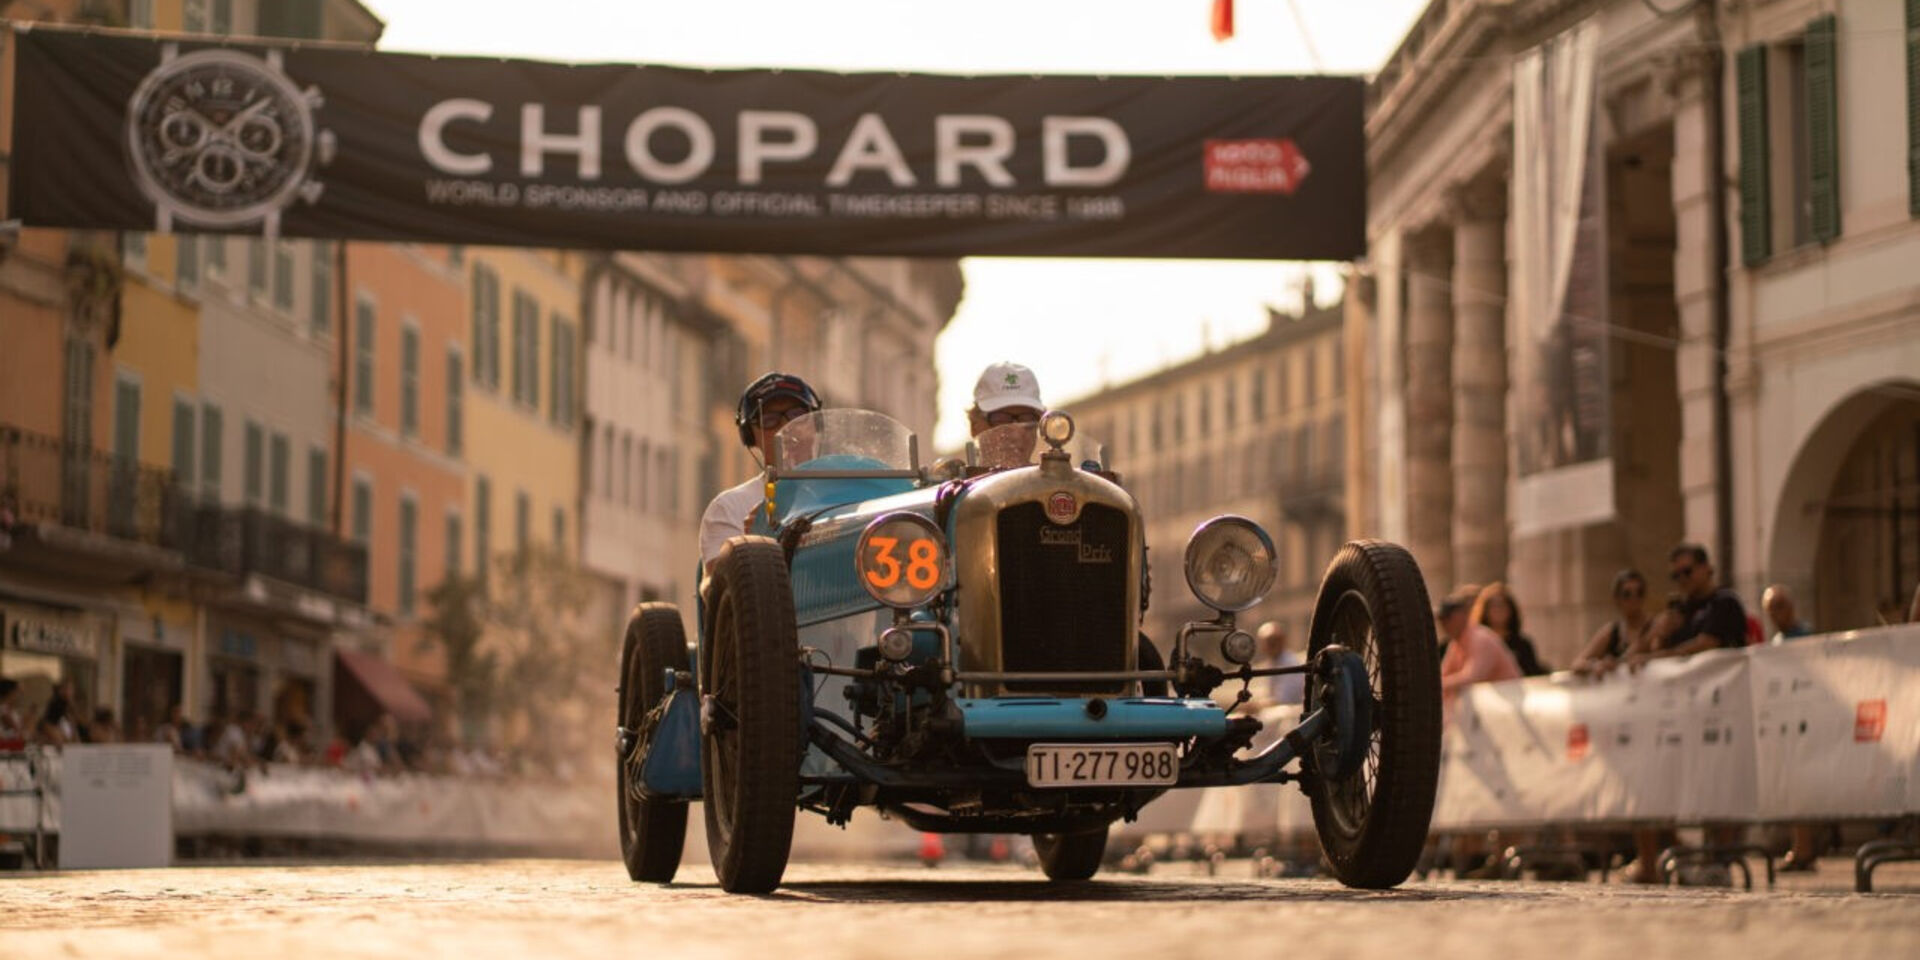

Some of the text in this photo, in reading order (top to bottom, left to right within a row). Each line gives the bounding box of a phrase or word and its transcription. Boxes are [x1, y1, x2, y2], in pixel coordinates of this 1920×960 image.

[418, 98, 1132, 186] CHOPARD
[426, 179, 520, 208] WORLD
[523, 184, 649, 211] SPONSOR
[651, 189, 709, 215] AND
[711, 191, 821, 217] OFFICIAL
[829, 192, 981, 218] TIMEKEEPER
[985, 195, 1058, 219] SINCE
[1041, 525, 1082, 543] Grand
[1081, 543, 1112, 560] Prix
[866, 537, 940, 589] 38
